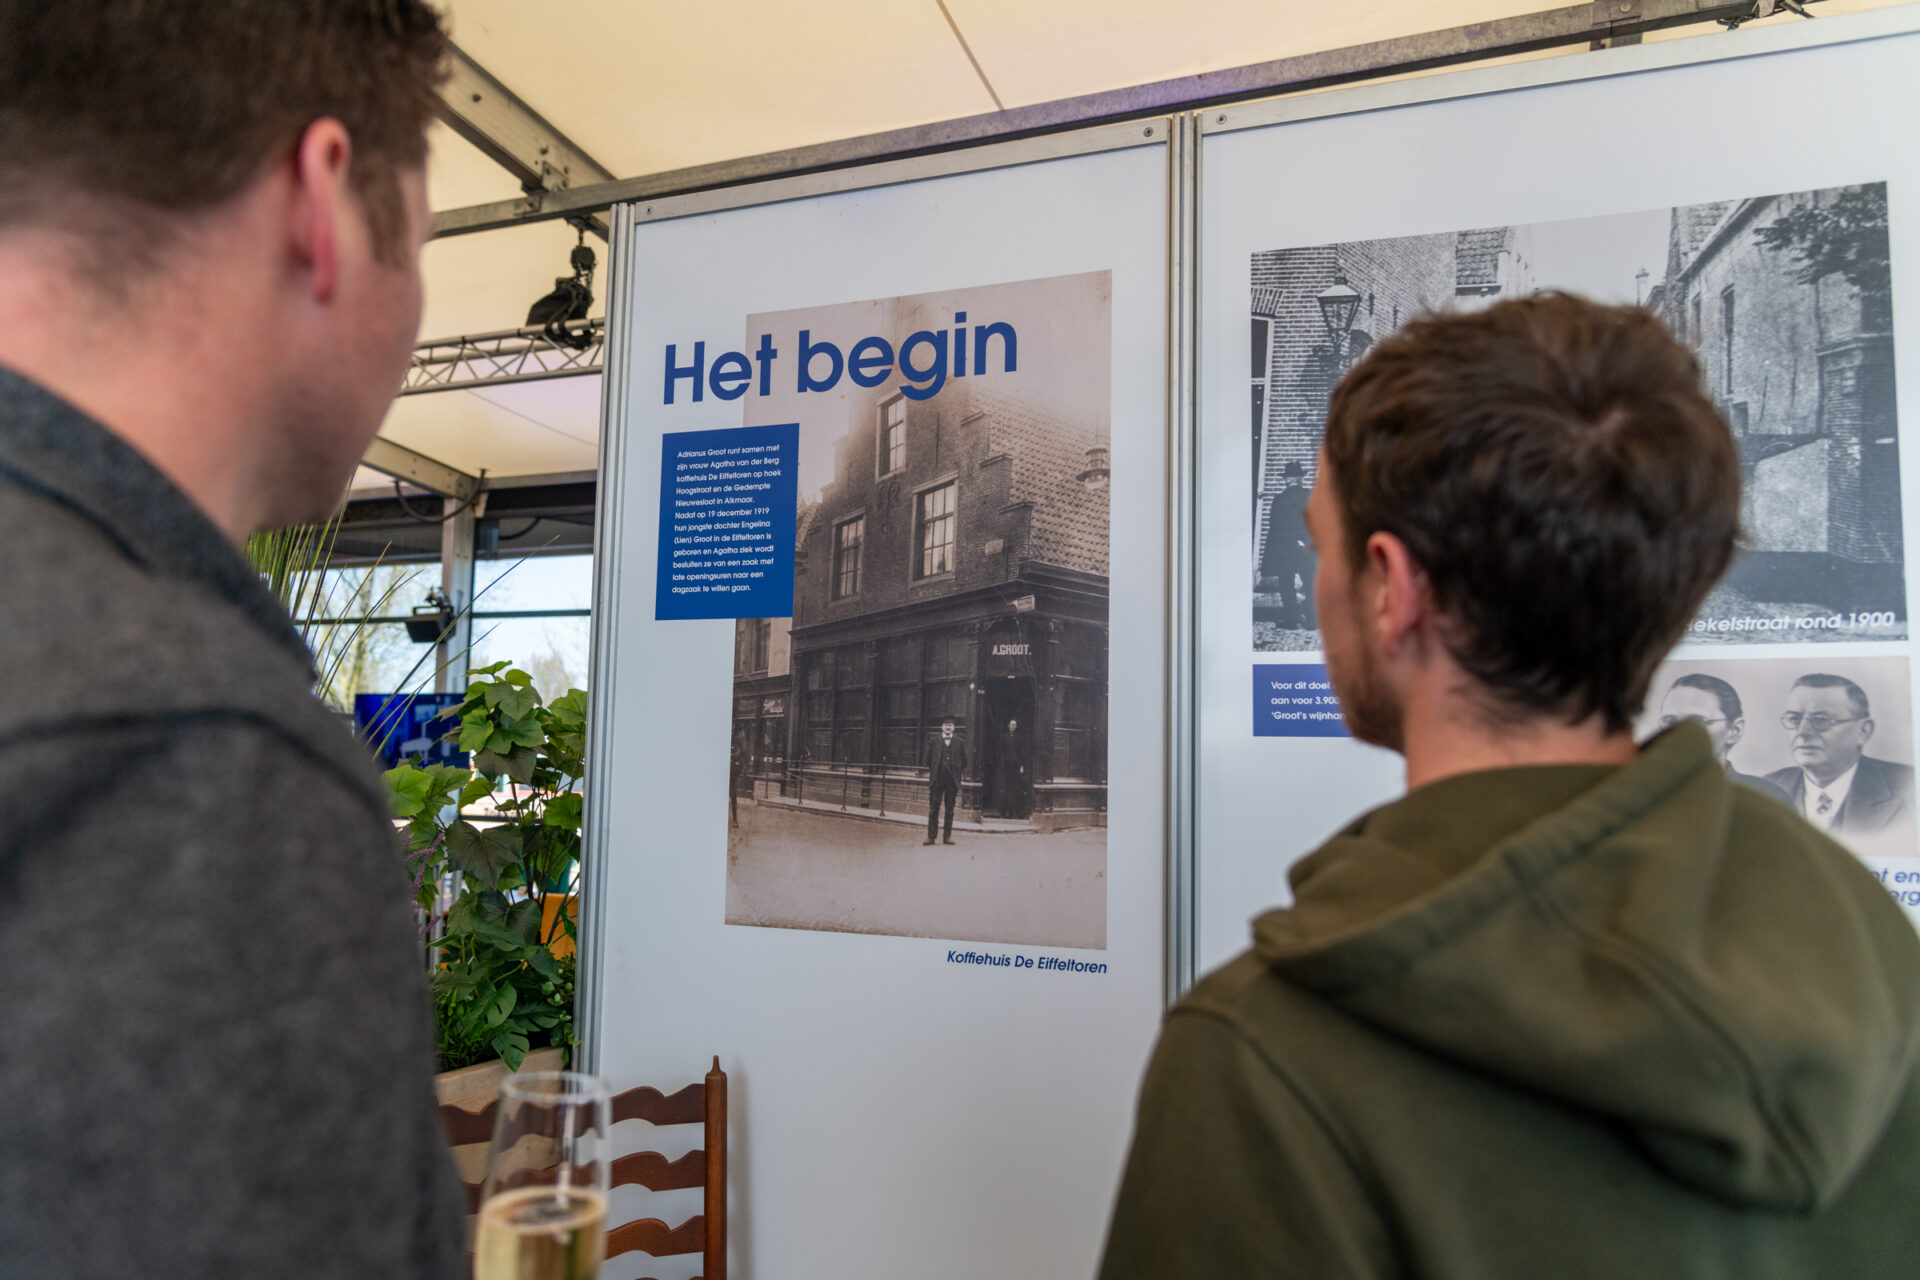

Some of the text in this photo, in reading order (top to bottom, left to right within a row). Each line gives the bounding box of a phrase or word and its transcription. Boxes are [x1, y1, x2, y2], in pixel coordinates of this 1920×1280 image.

[663, 311, 1017, 405] Het begin
[677, 443, 779, 458] Adrianus Groot runt samen met
[676, 463, 687, 471] zijn
[709, 460, 735, 470] Agatha
[736, 459, 749, 467] van
[750, 458, 762, 466] der
[763, 457, 779, 466] Berg
[676, 469, 781, 483] koffiehuis De Eiffeltoren op hoek
[675, 485, 712, 496] Hoogstraat
[723, 485, 732, 493] de
[733, 482, 770, 491] Gedempte
[716, 497, 722, 505] in
[674, 511, 695, 519] Nadat
[696, 511, 706, 519] op
[716, 509, 752, 517] december
[754, 507, 770, 515] 1919
[687, 523, 712, 532] jongste
[713, 521, 740, 530] dochter
[741, 520, 770, 530] Engelina
[673, 536, 692, 545] (Lien)
[693, 535, 712, 543] Groot
[721, 534, 730, 542] de
[731, 533, 764, 541] Eiffeltoren
[765, 532, 771, 540] is
[673, 549, 701, 558] geboren
[712, 547, 738, 556] Agatha
[754, 545, 774, 553] wordt
[672, 561, 702, 569] besluiten
[727, 559, 740, 567] een
[741, 558, 758, 566] zaak
[759, 557, 774, 565] met
[672, 573, 685, 581] late
[685, 573, 731, 581] openingsuren
[671, 584, 751, 595] dagzaak te willen gaan.
[1795, 613, 1842, 629] rond
[1848, 611, 1895, 628] 1900
[1271, 681, 1330, 690] Voor dit doel
[1270, 697, 1289, 705] aan
[1291, 697, 1313, 705] voor
[1894, 871, 1920, 884] en
[947, 950, 1108, 974] Koffiehuis De Eiffeltoren
